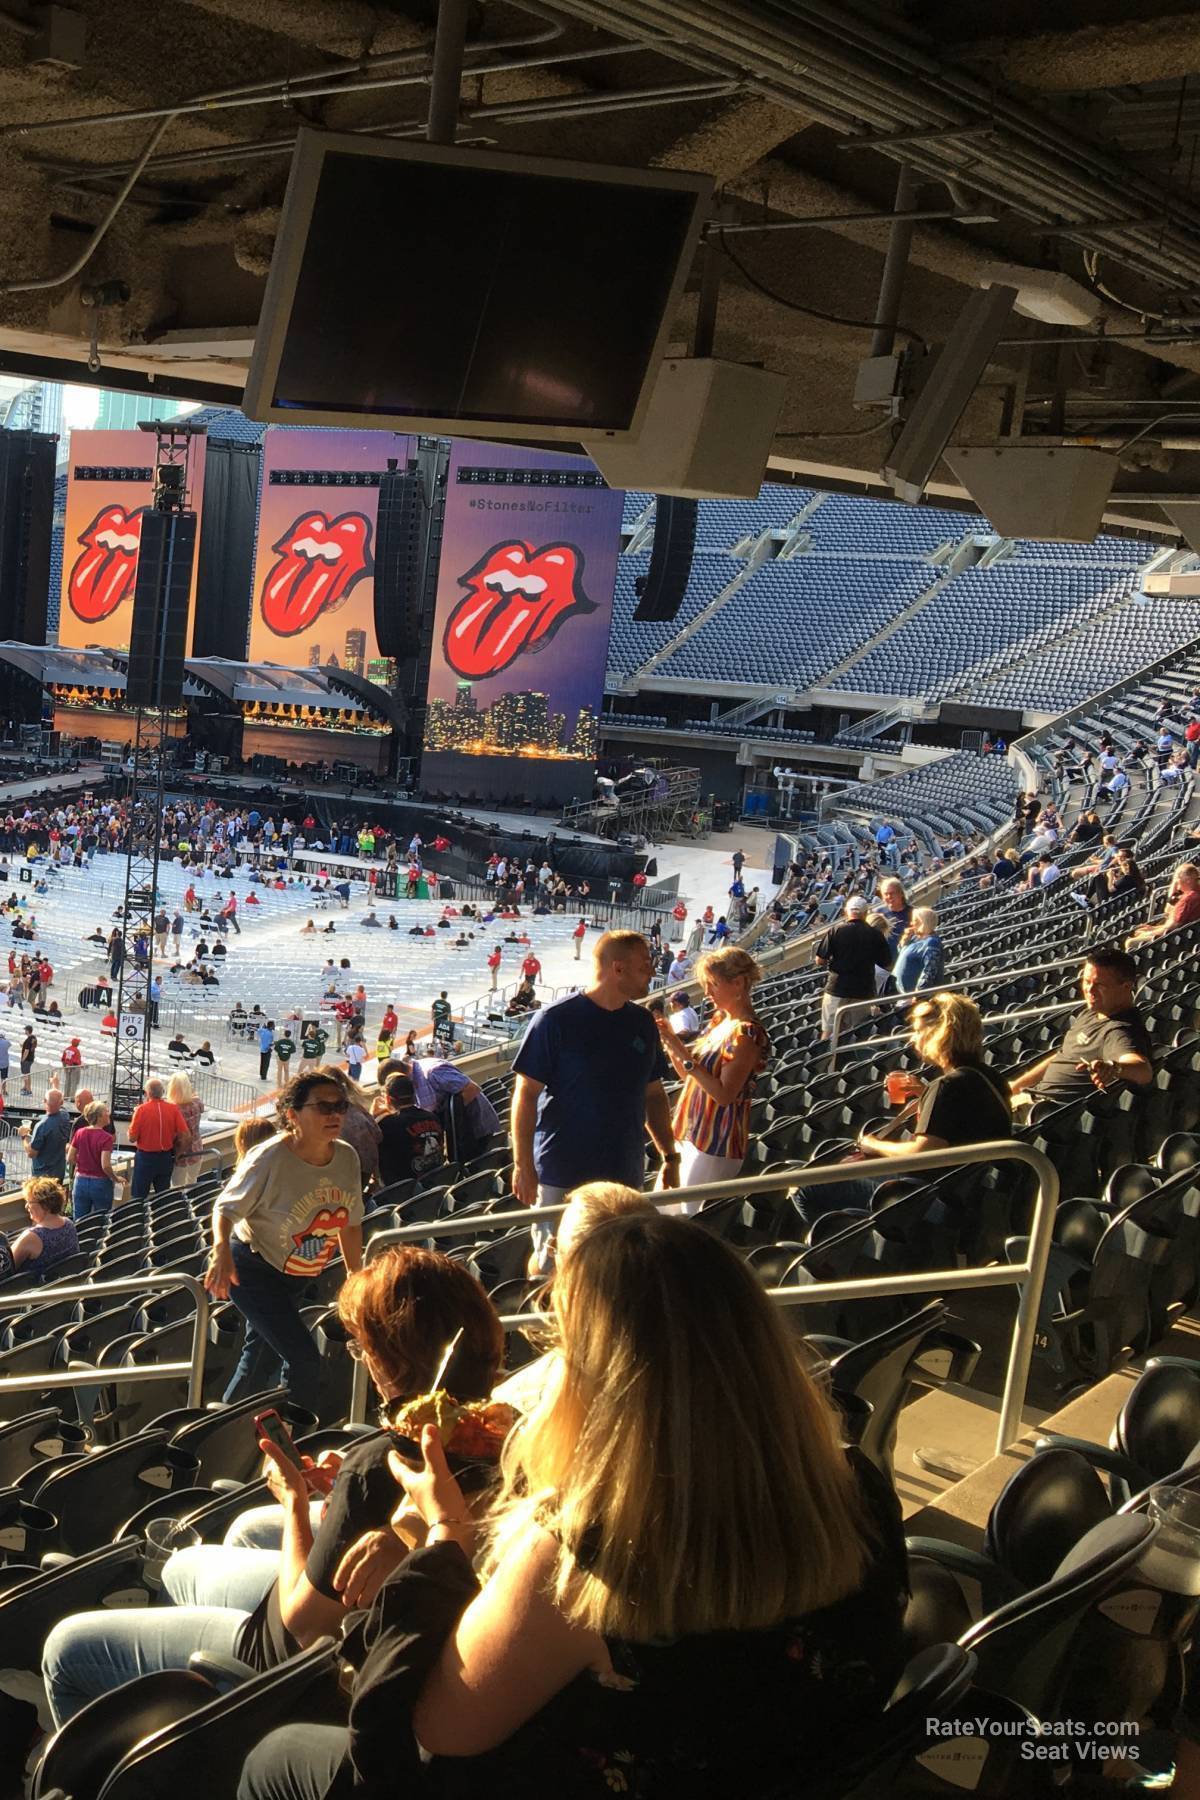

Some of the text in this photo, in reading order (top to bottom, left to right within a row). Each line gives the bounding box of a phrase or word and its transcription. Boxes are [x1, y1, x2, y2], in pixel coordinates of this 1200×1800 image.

[469, 499, 595, 514] #StonesNoFilter
[22, 870, 29, 880] B
[100, 990, 108, 1003] A
[122, 1015, 135, 1024] PIT
[437, 1023, 450, 1031] ADA
[1035, 1334, 1048, 1348] 14
